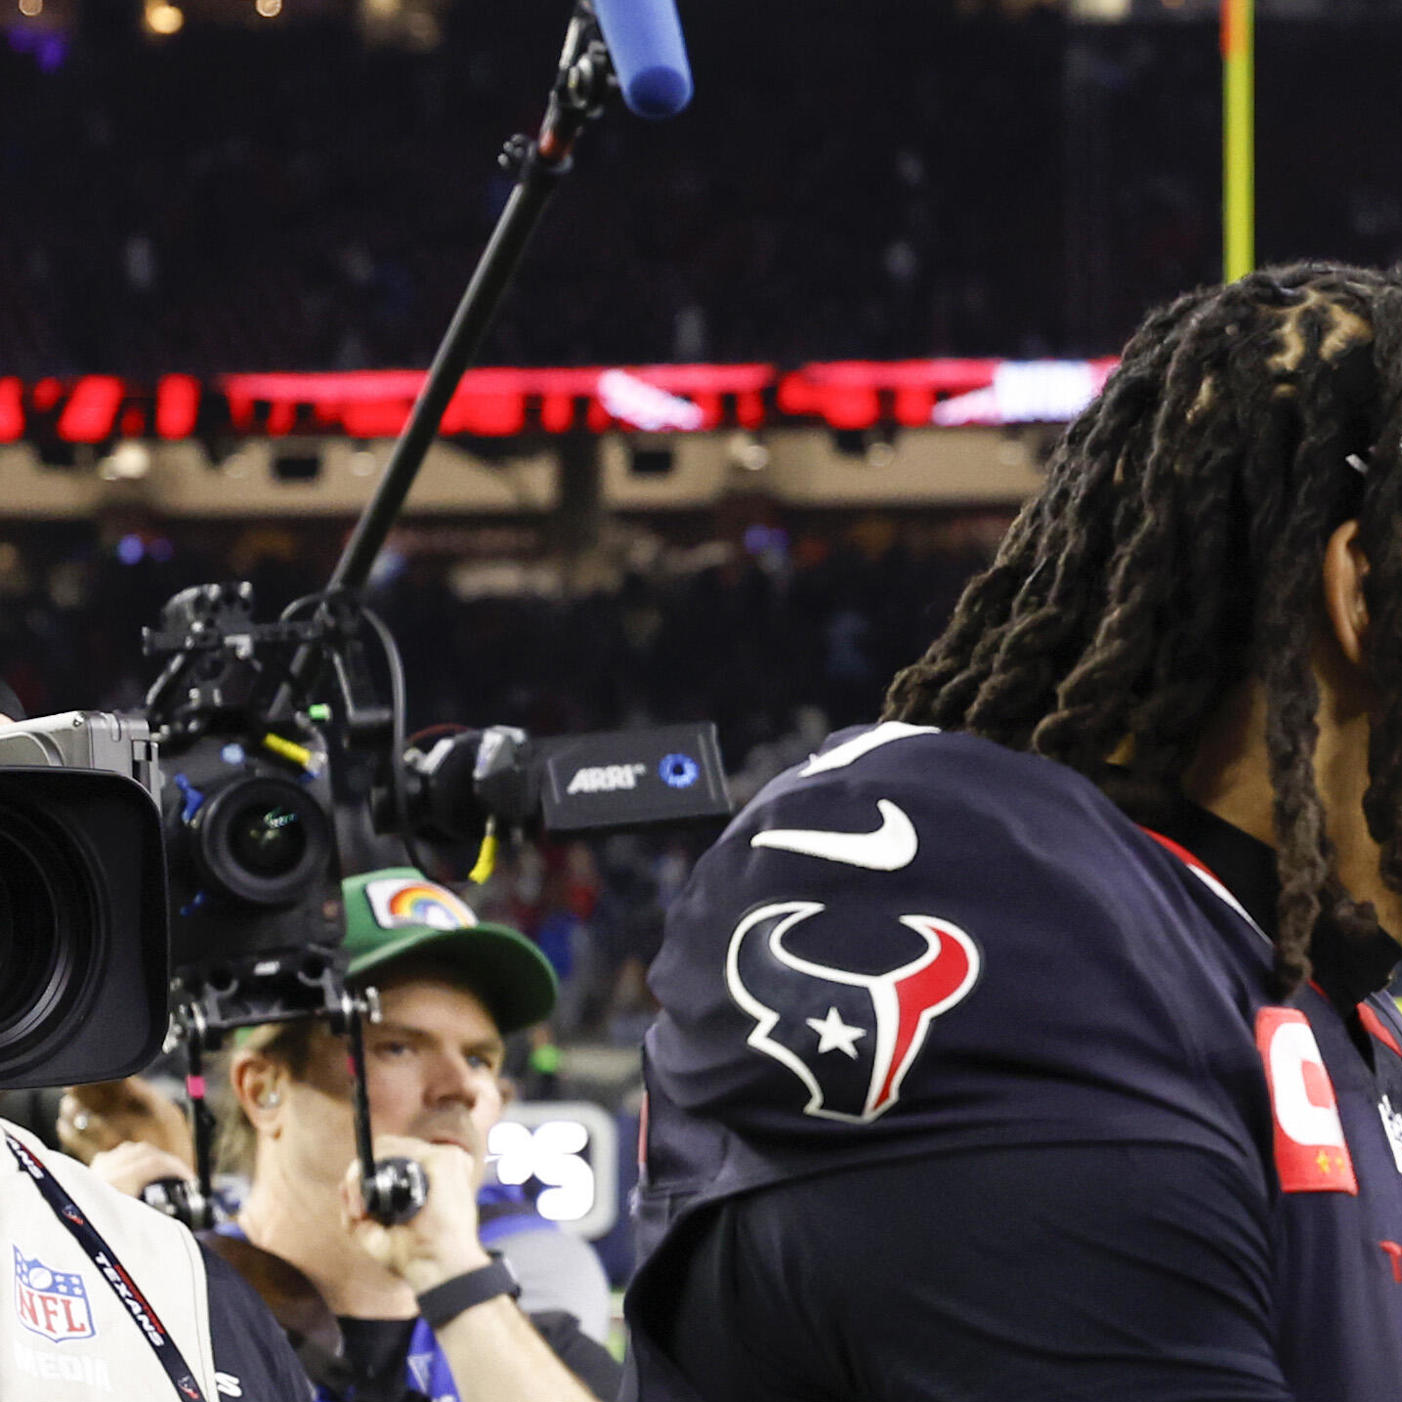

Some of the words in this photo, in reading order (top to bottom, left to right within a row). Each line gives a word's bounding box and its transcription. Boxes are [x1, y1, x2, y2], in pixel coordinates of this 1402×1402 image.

[1270, 1022, 1346, 1147] C
[18, 1283, 86, 1334] NFL
[95, 1250, 164, 1347] TEXANS
